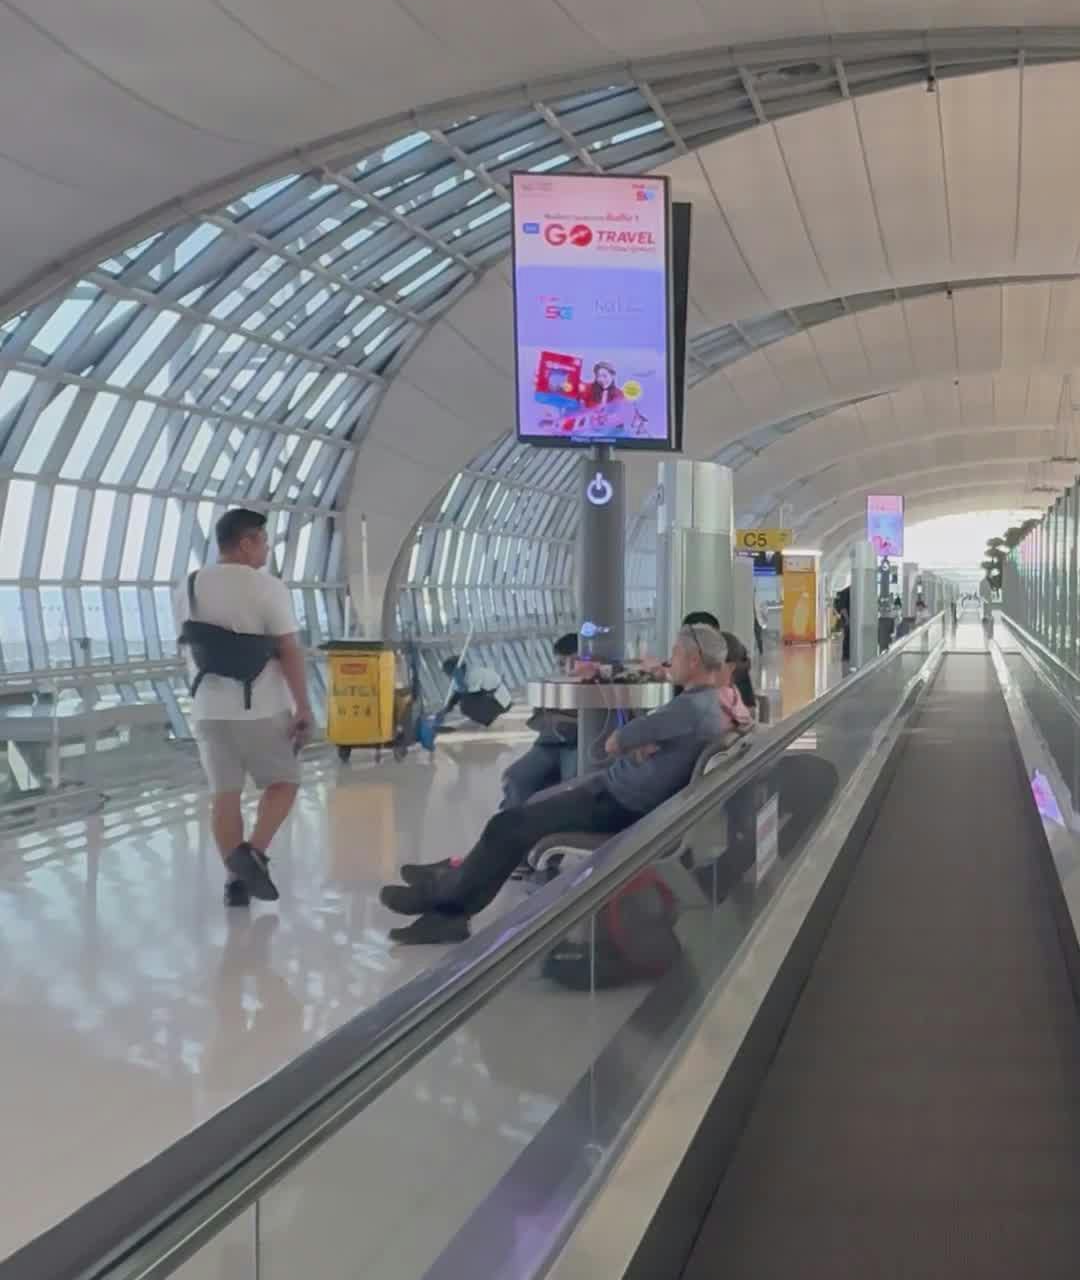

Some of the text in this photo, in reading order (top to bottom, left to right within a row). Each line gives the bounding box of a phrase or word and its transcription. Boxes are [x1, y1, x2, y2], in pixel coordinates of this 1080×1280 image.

[545, 223, 593, 247] GO
[596, 229, 656, 244] TRAVEL
[743, 532, 767, 547] C5
